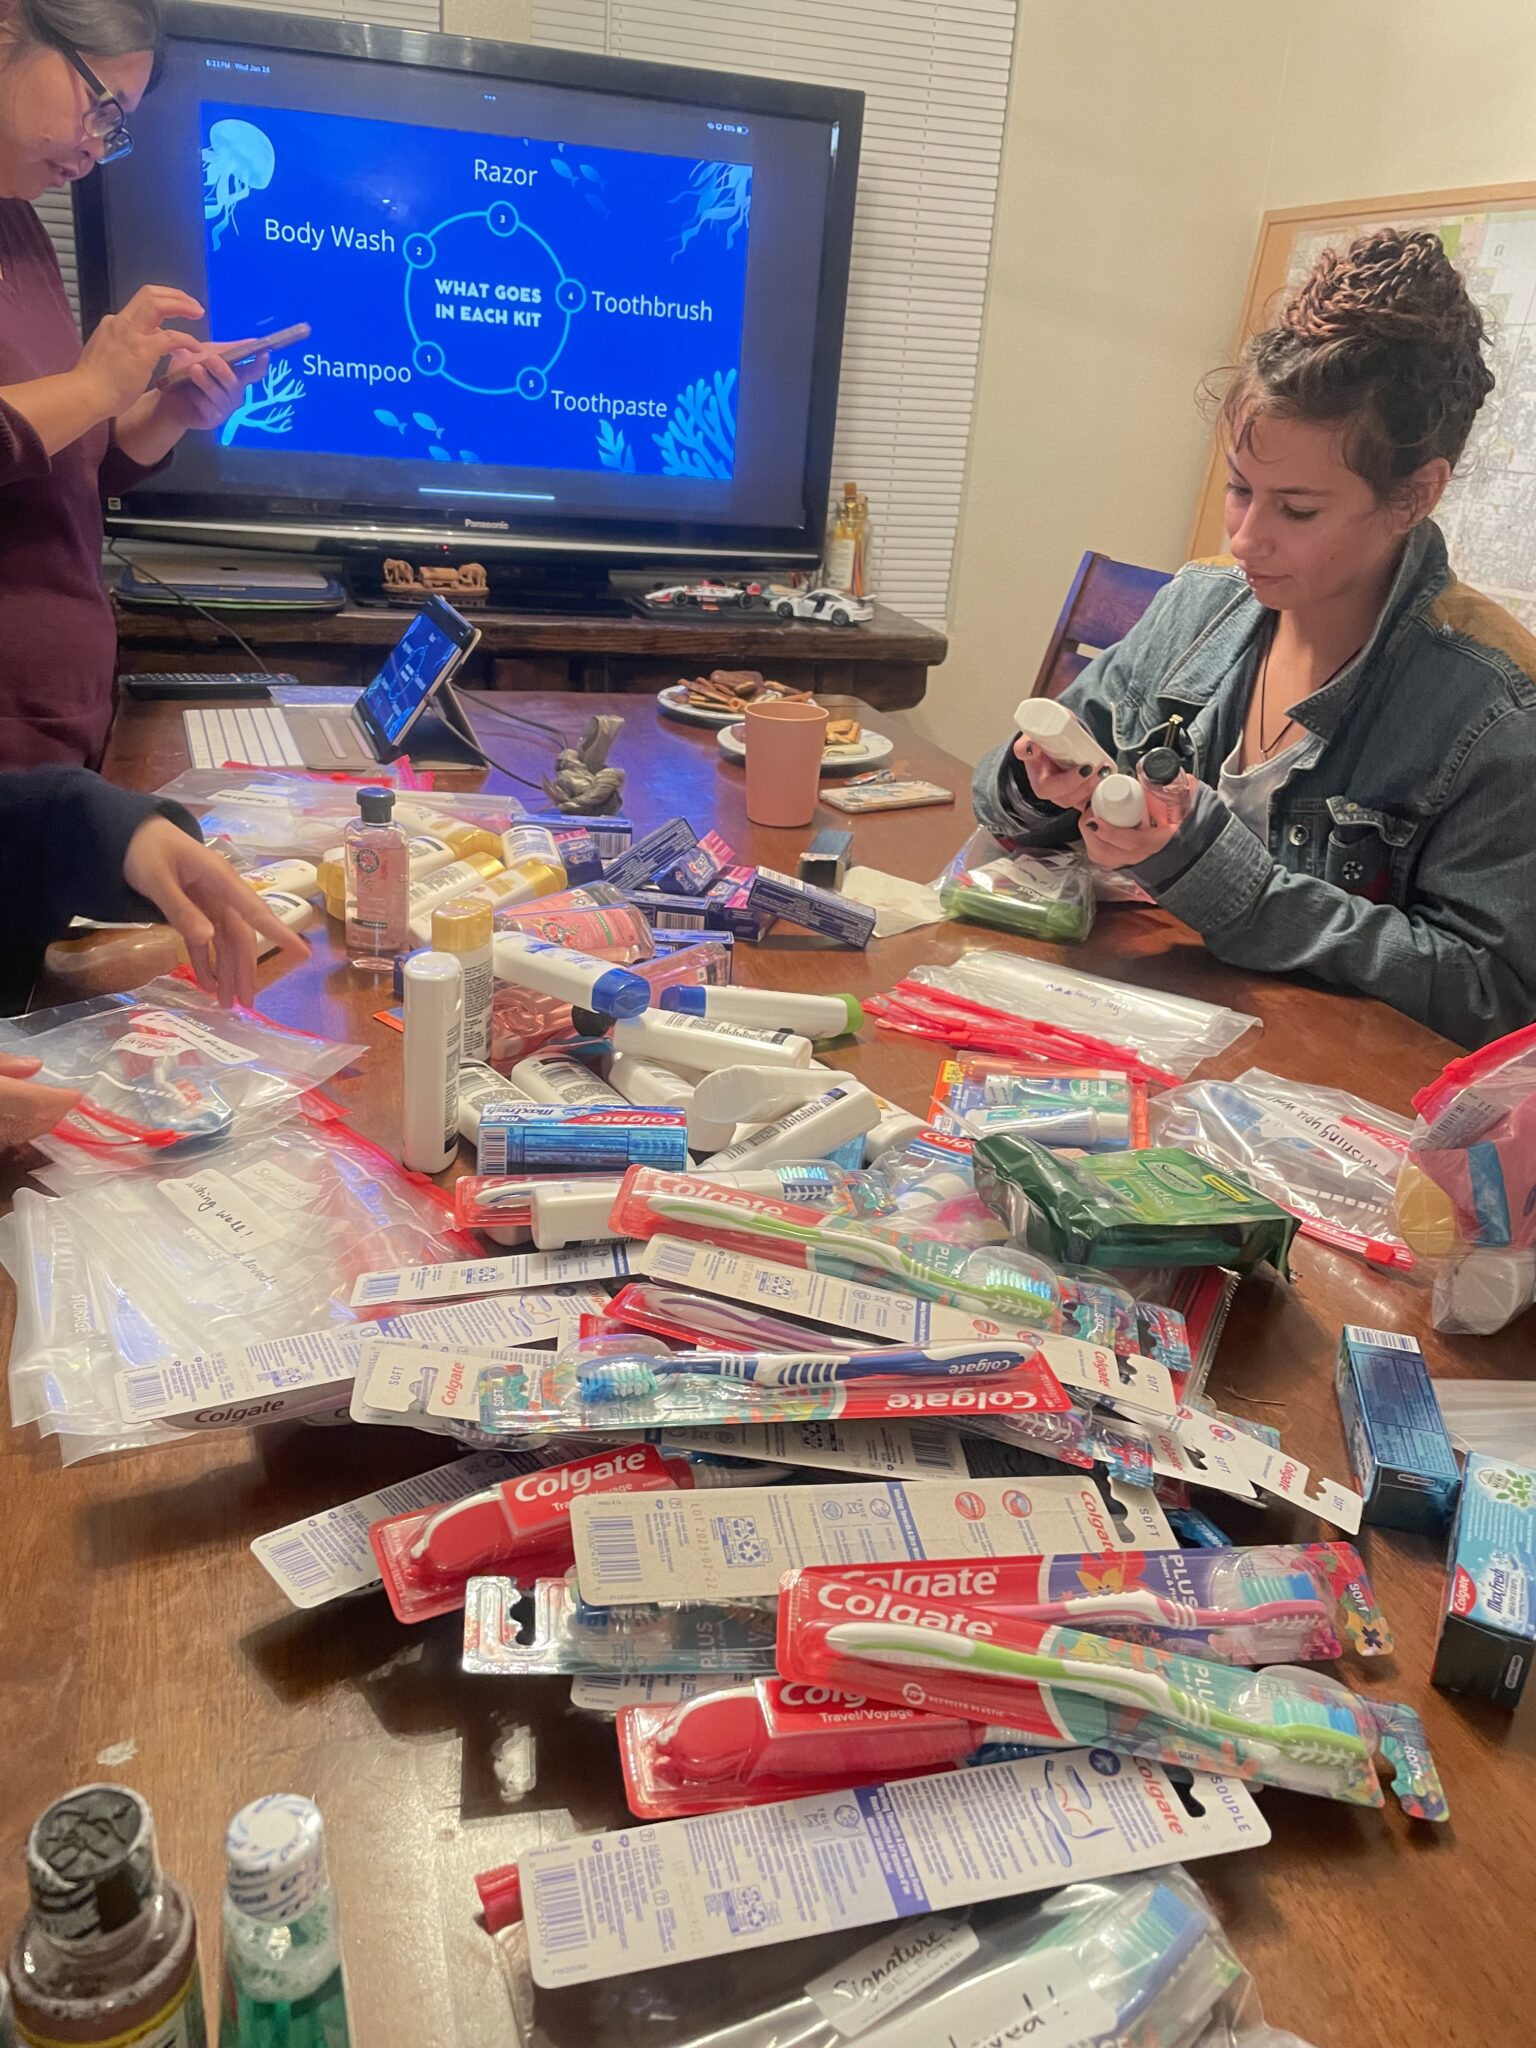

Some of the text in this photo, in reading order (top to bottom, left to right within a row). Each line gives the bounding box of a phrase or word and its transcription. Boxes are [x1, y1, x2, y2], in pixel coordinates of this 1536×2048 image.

[474, 159, 538, 187] Razor
[499, 214, 505, 223] 3
[265, 218, 395, 253] Body Wash
[416, 246, 422, 256] 2
[435, 279, 542, 304] WHAT GOES
[568, 291, 573, 301] 4
[592, 290, 713, 322] Toothbrush
[435, 303, 542, 328] IN EACH KIT
[303, 354, 412, 385] Shampoo
[427, 354, 431, 363] 1
[529, 379, 534, 388] 5
[551, 390, 668, 419] Toothpaste
[589, 1115, 681, 1126] Colgate
[934, 1247, 951, 1274] PLU
[71, 1293, 95, 1337] STORAGE
[388, 1366, 405, 1386] SOFT
[948, 1359, 1011, 1375] Colgate
[1094, 1351, 1112, 1390] Colgate
[441, 1359, 465, 1407] Colgate
[494, 1389, 505, 1407] SOFT
[194, 1398, 285, 1425] Colgate
[886, 1387, 1038, 1410] Colgate
[1158, 1434, 1184, 1472] Colgate
[515, 1449, 647, 1502] Colgate
[1278, 1461, 1298, 1492] Colgate
[1139, 1508, 1160, 1538] SOFT
[1349, 1582, 1370, 1614] SOFT
[1454, 1574, 1470, 1612] Colgate
[817, 1583, 994, 1637] Colgate
[699, 1618, 716, 1669] PLUS
[1194, 1663, 1215, 1704] PLU
[819, 1708, 915, 1724] Travel/Voyage
[1406, 1743, 1423, 1781] SOFT
[1210, 1774, 1252, 1833] SOUPLE
[833, 1929, 945, 2005] Signature
[881, 1938, 953, 1996] SELECT
